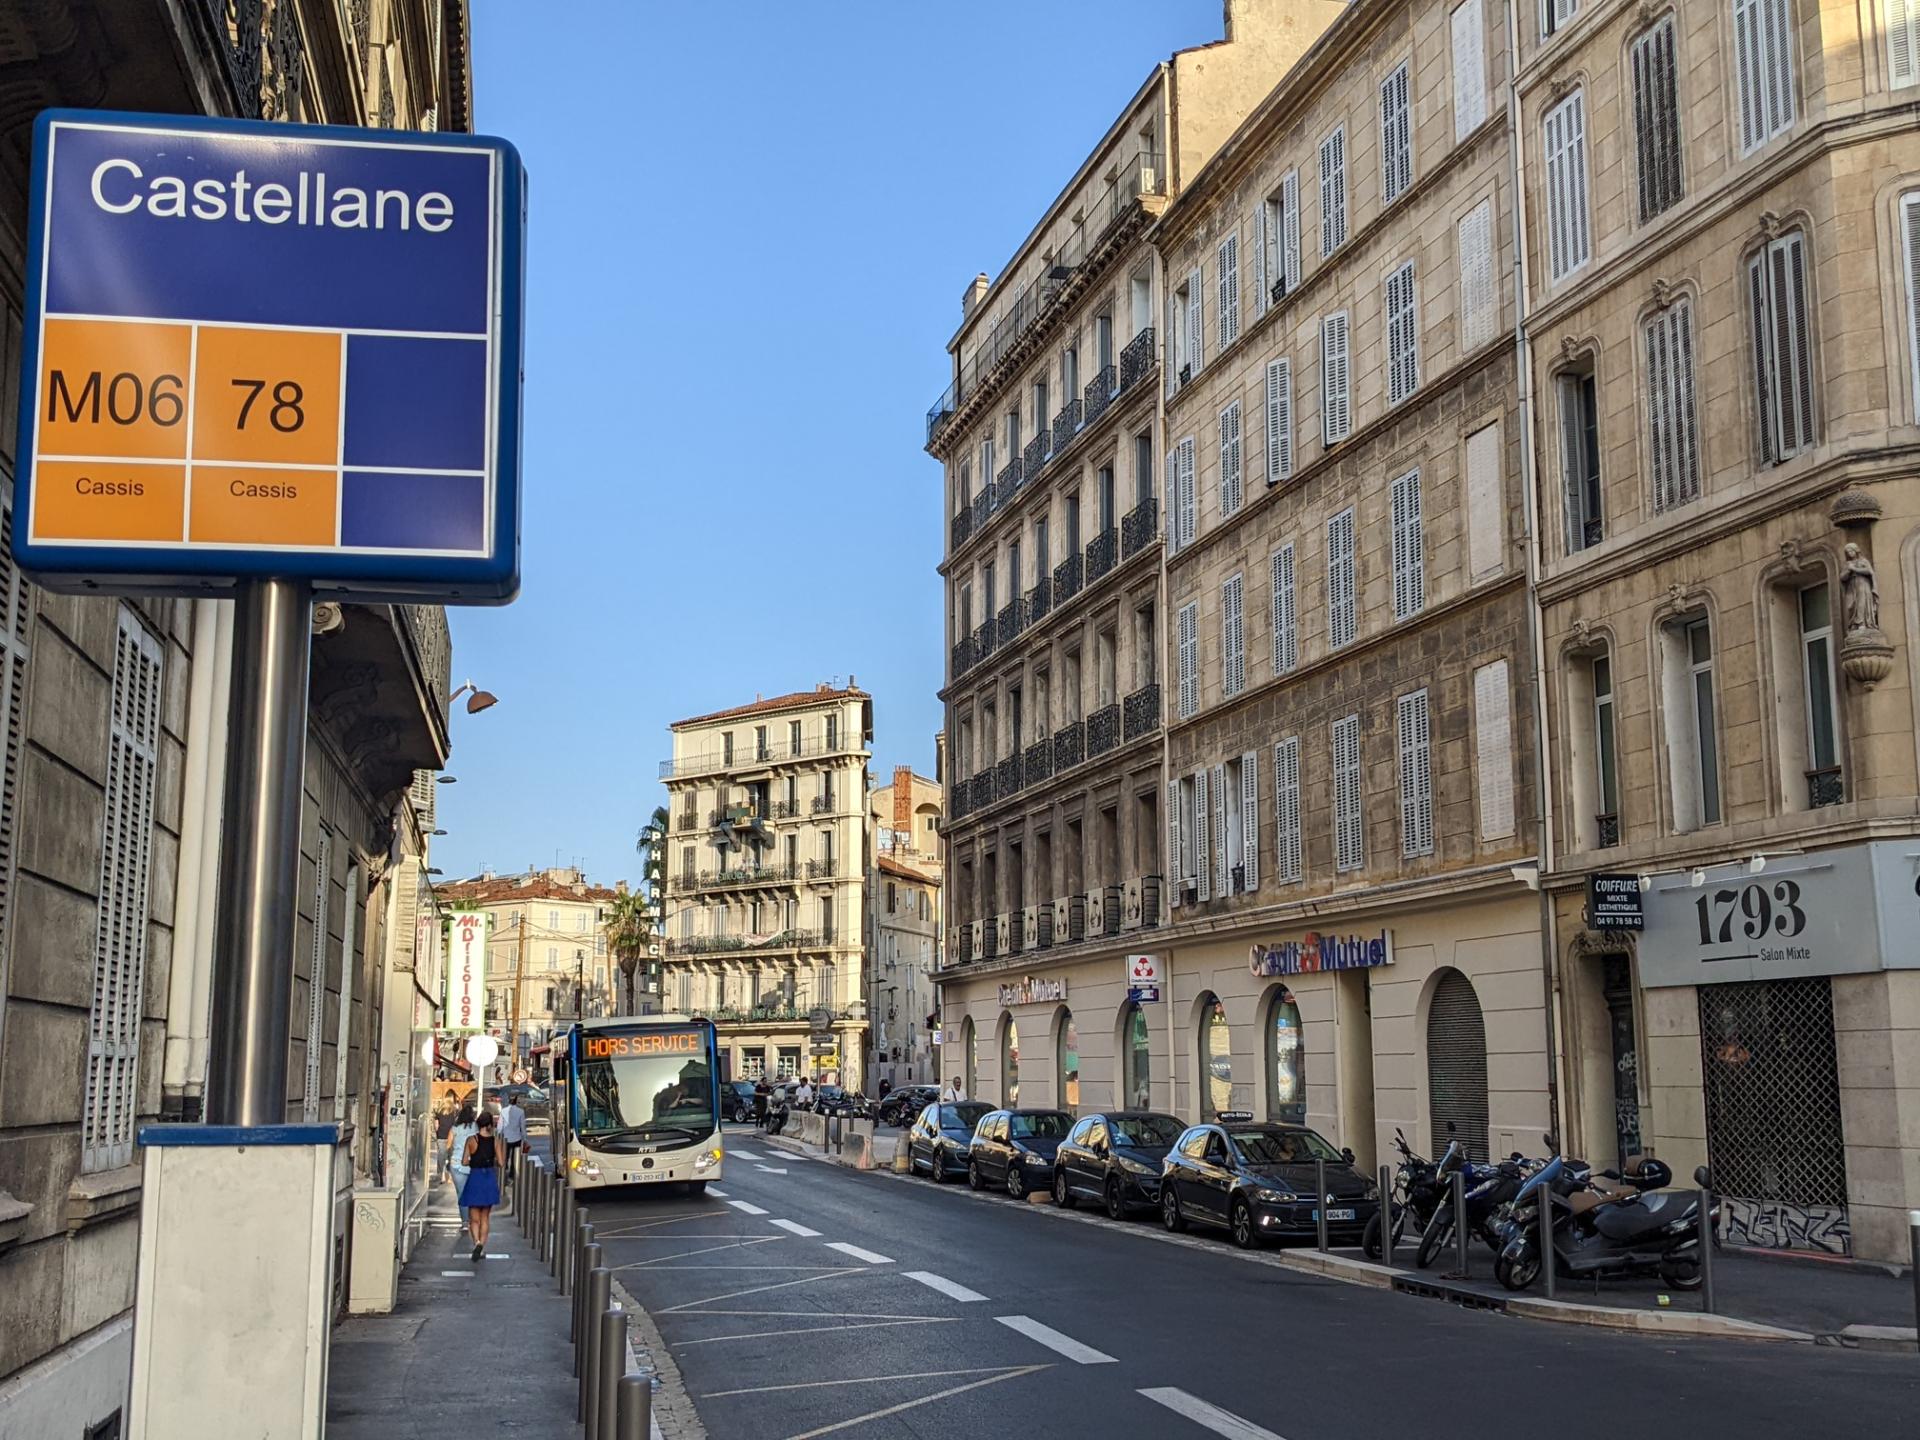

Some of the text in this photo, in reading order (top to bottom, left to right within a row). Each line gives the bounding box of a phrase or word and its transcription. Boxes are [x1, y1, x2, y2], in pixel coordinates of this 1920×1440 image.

[91, 158, 454, 232] Castellane
[47, 369, 184, 427] M06
[230, 379, 305, 433] 78
[75, 477, 144, 496] Cassis
[229, 480, 297, 499] Cassis
[1595, 880, 1638, 892] COIFFURE
[649, 831, 661, 993] PHARMACIE
[1596, 917, 1605, 925] 04
[1606, 917, 1614, 925] 91
[1615, 917, 1623, 925] 78
[1633, 917, 1642, 925] 43
[1694, 880, 1806, 946] 1793
[1319, 928, 1395, 970] Mutuel
[1760, 947, 1811, 961] Salon Mixte
[456, 915, 482, 1027] Mr. Bricolage
[1030, 976, 1068, 1002] Mutuel
[588, 1034, 698, 1056] HORS SERVICE
